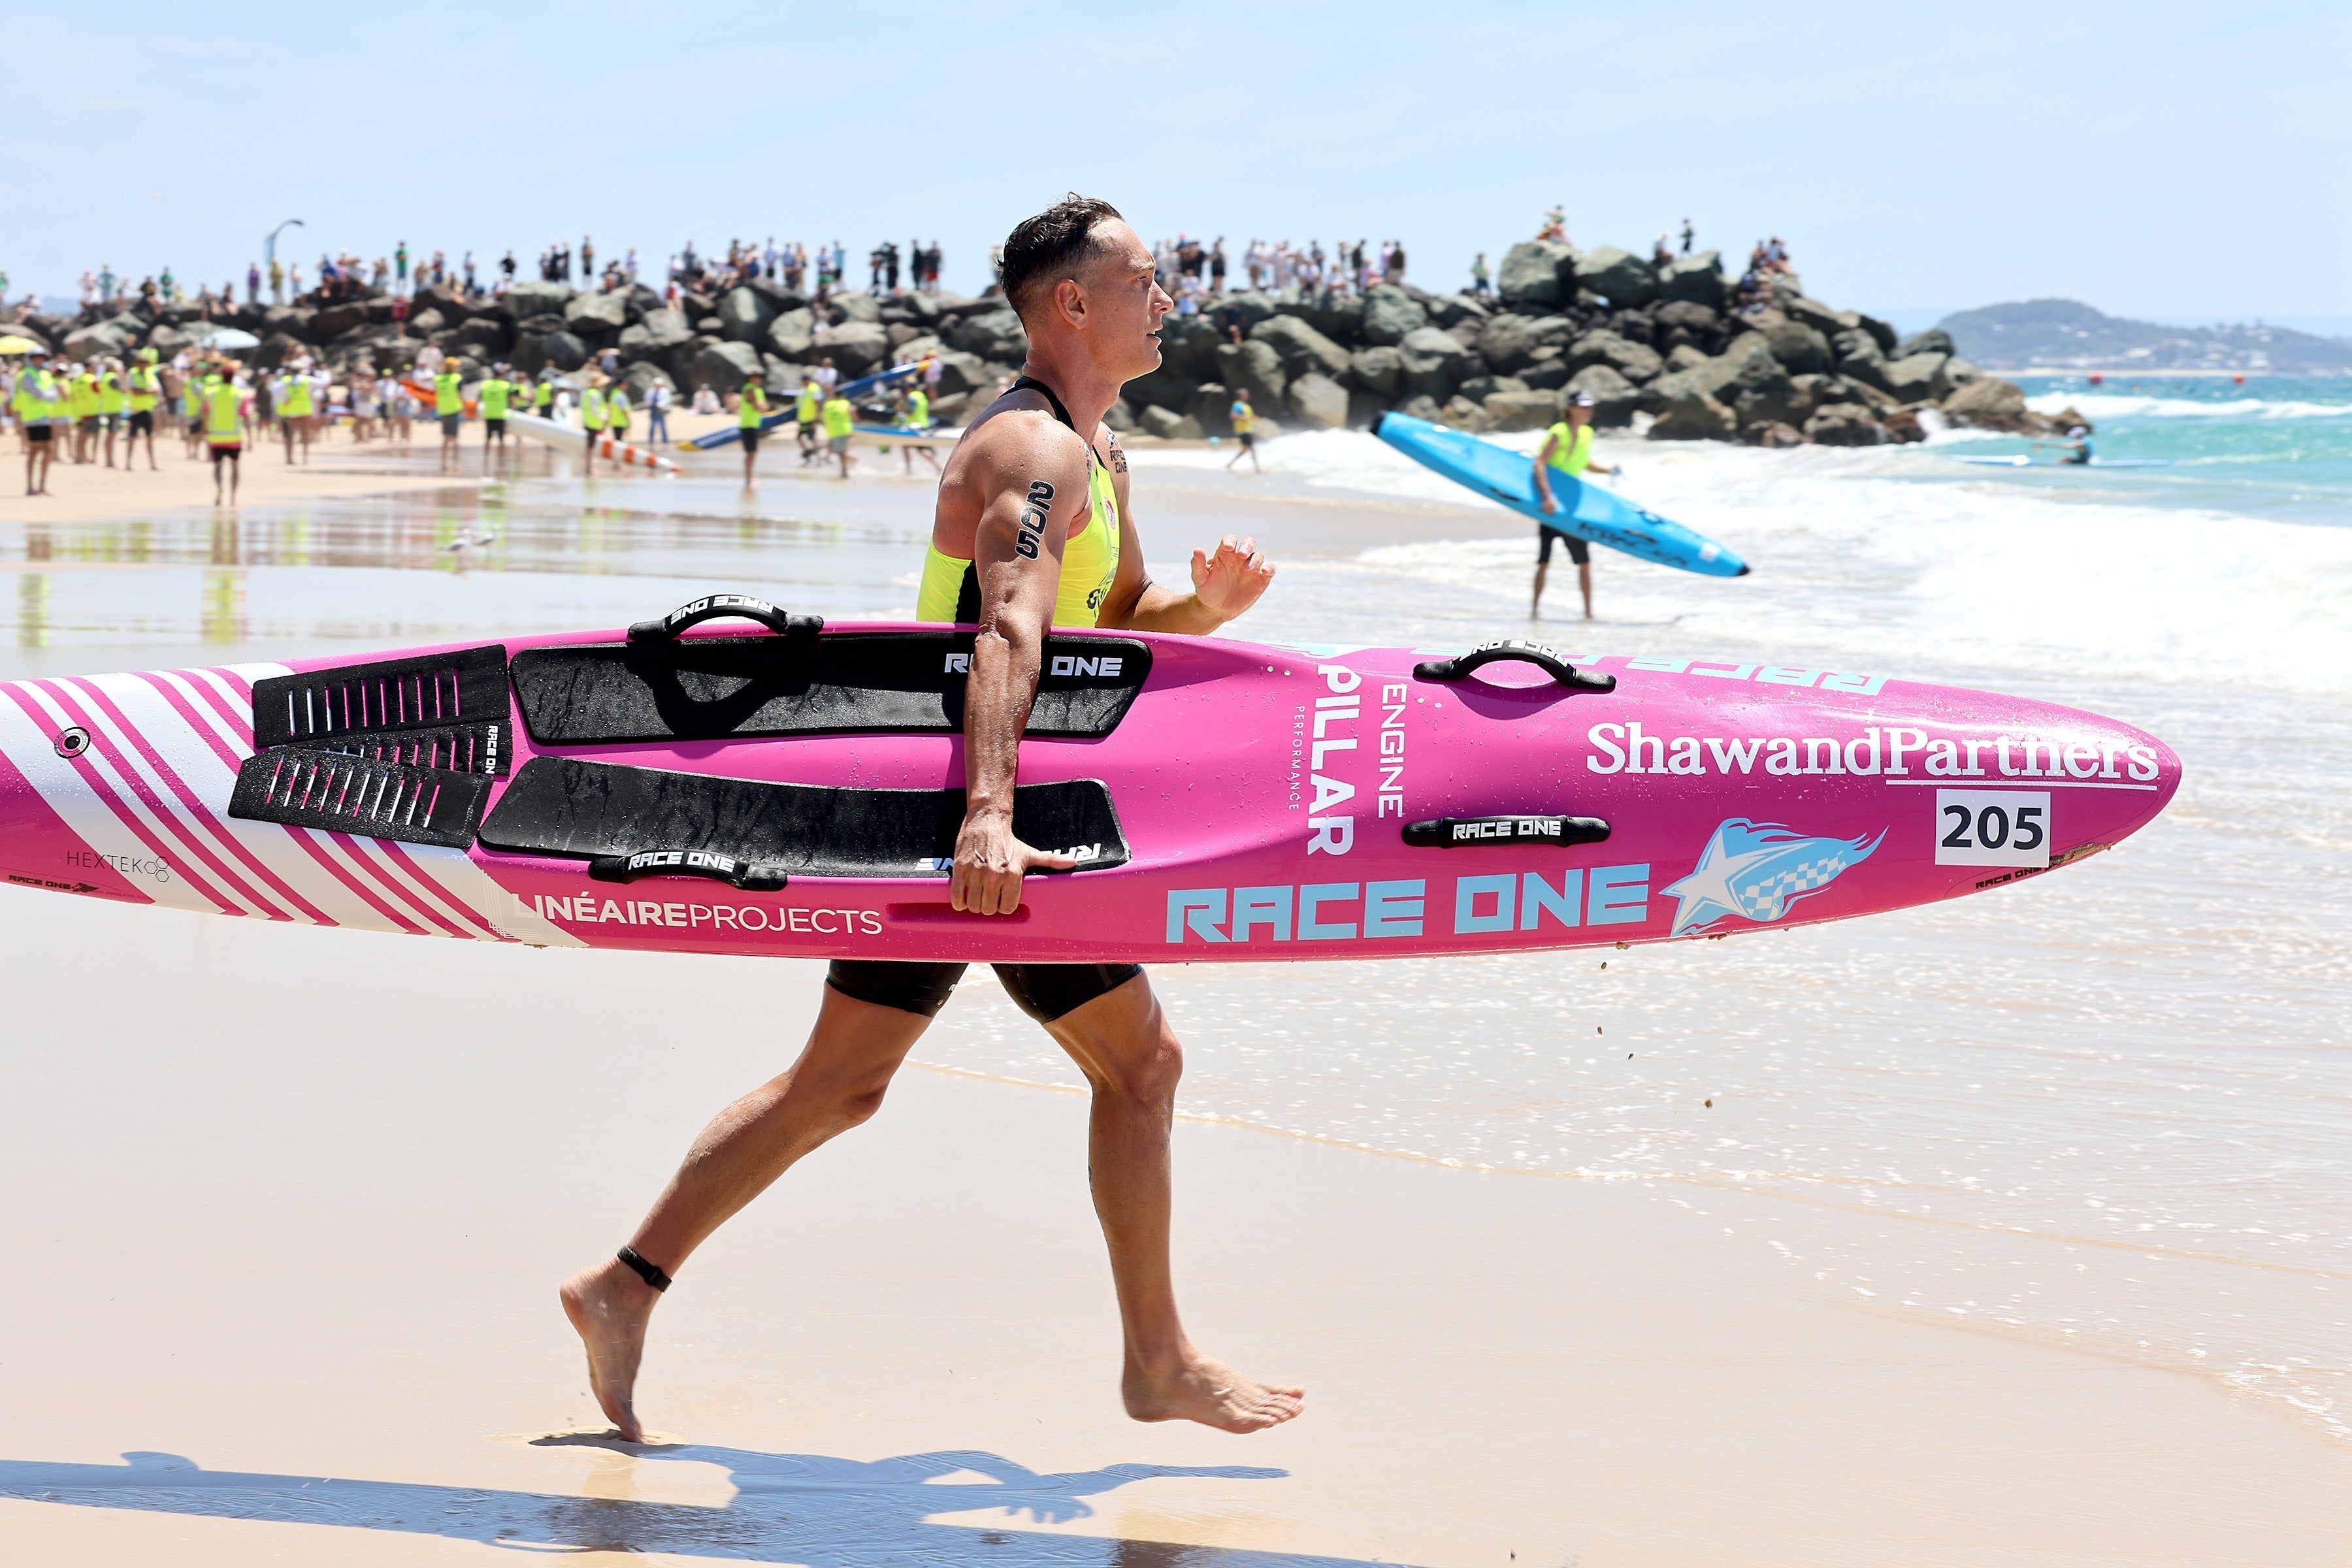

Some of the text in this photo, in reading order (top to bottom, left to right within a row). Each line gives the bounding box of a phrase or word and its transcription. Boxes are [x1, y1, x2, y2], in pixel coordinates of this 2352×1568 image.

[1015, 480, 1055, 561] 205
[670, 595, 774, 625] RACE ONE
[1051, 656, 1122, 676] ONE
[485, 725, 498, 774] RACE ON
[1288, 706, 1305, 810] PERFORMANCE
[1307, 664, 1362, 856] PILLAR
[1379, 684, 1407, 818] ENGINE
[1453, 819, 1561, 840] RACE ONE
[1942, 805, 2044, 850] 205
[67, 851, 142, 874] HEXTEK
[628, 851, 736, 873] RACE ONE
[8, 874, 71, 890] RACE ONE
[1976, 873, 2012, 889] RACE
[1166, 863, 1650, 943] RACE ONE
